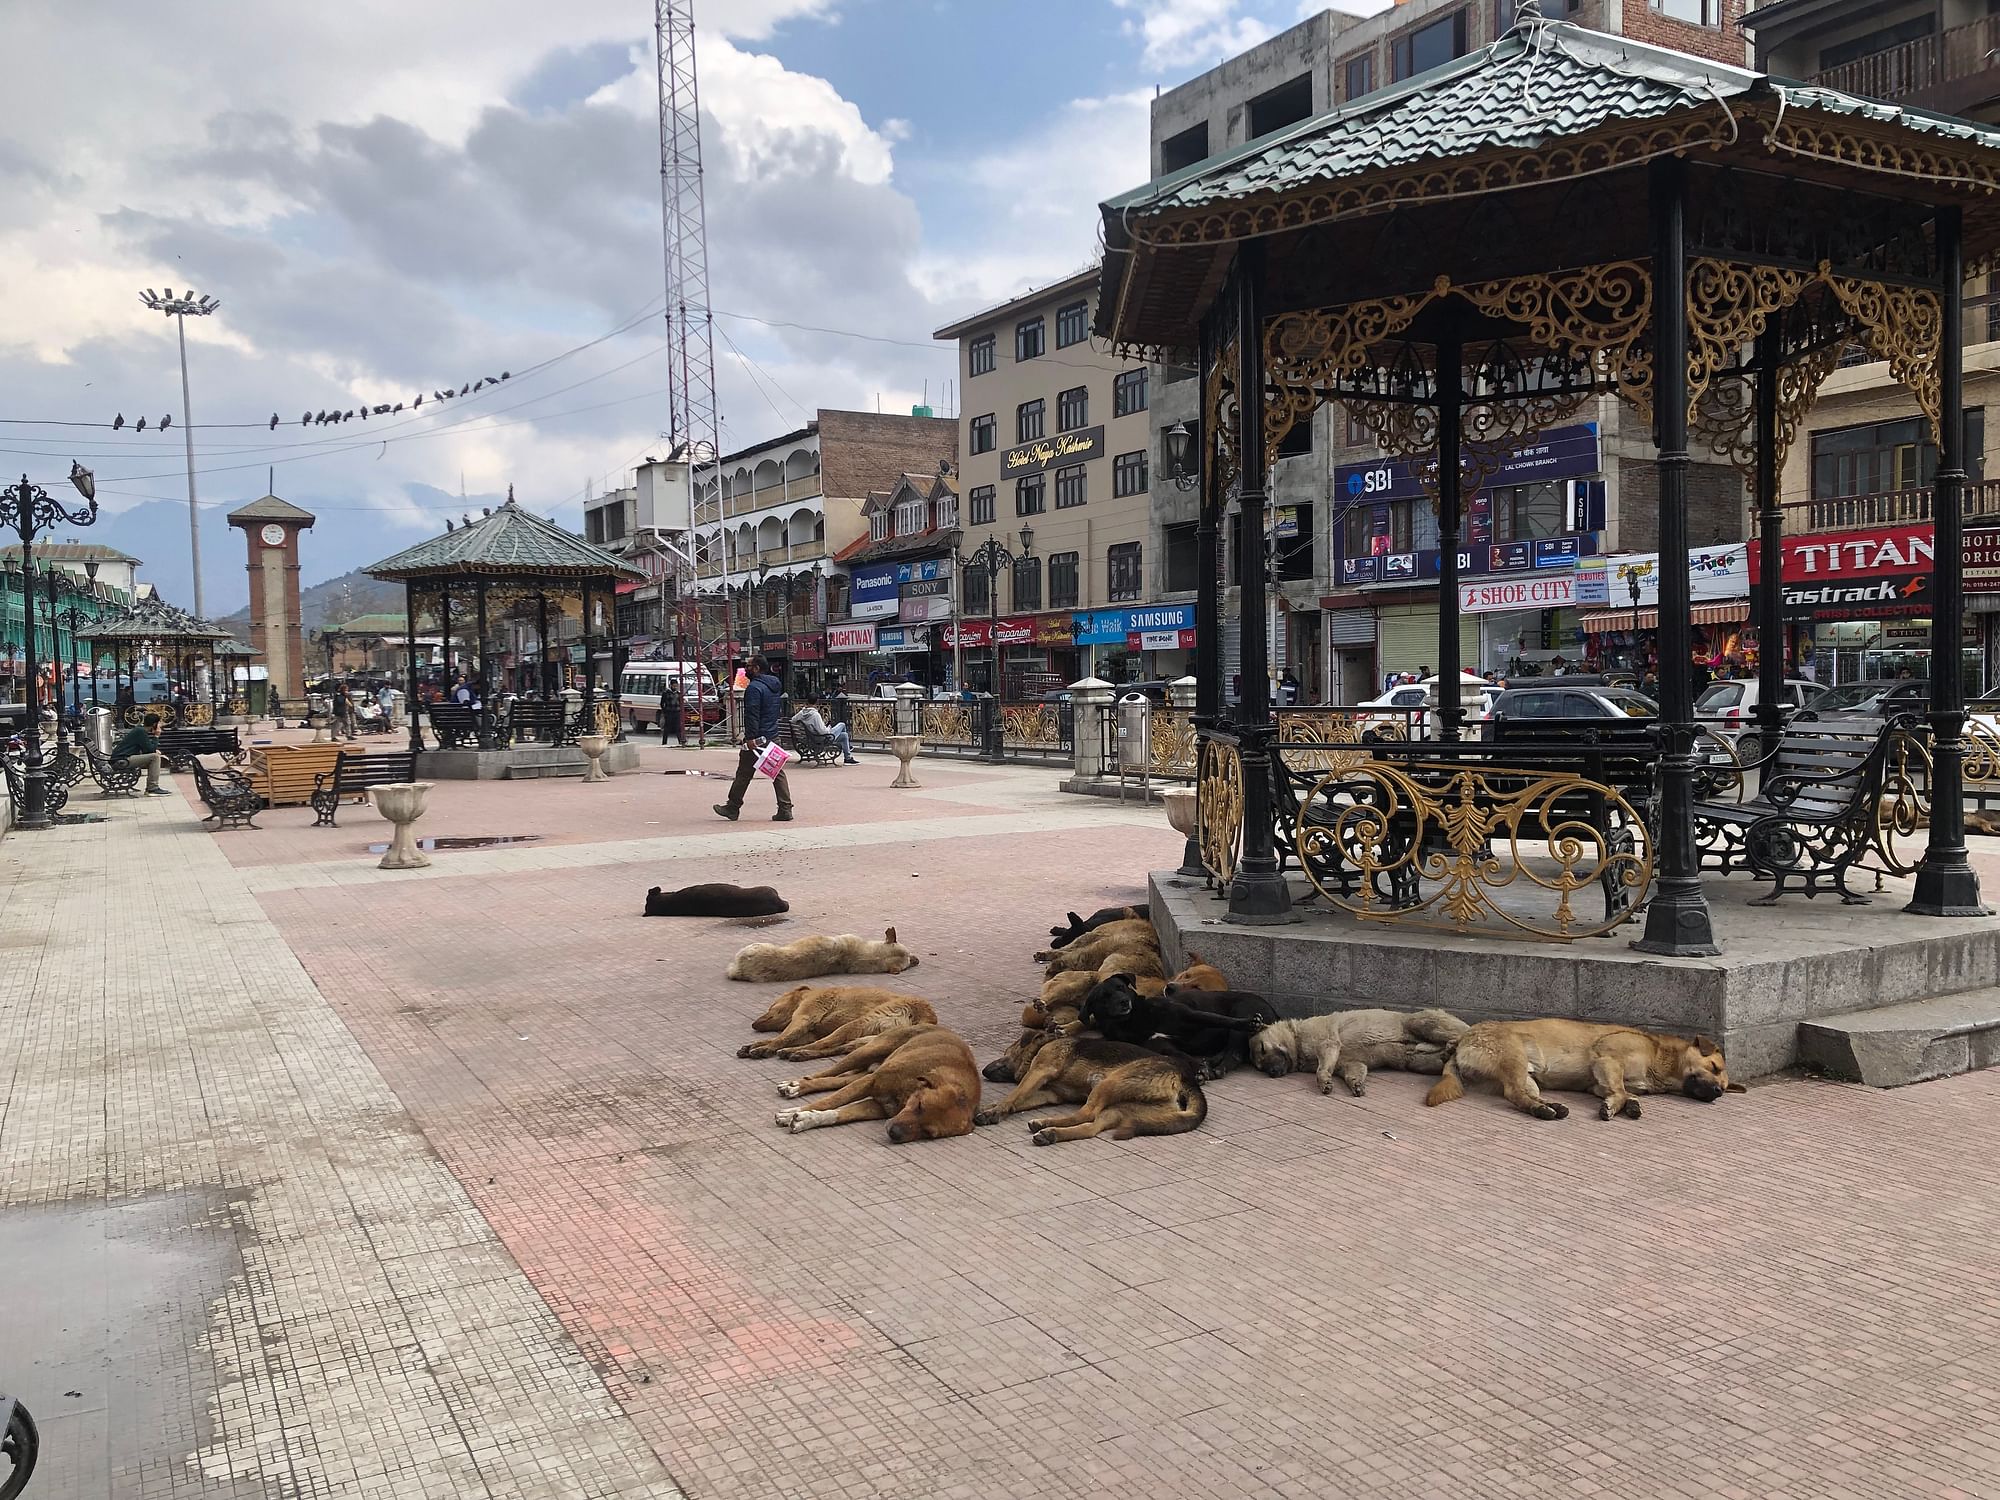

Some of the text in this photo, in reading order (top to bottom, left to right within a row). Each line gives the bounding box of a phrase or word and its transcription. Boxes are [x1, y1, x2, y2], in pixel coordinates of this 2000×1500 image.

[1007, 451, 1030, 468] Hotel
[1055, 436, 1094, 457] Kashmir
[1535, 457, 1557, 467] BRANCH
[1365, 468, 1392, 493] SBI
[1457, 552, 1471, 569] BI
[1794, 535, 1934, 573] TITAN
[1712, 568, 1730, 577] TOYS
[856, 573, 893, 590] Panasonic
[912, 582, 938, 595] SONY
[1481, 580, 1572, 605] SHOE CITY
[914, 605, 923, 616] LG
[1854, 603, 1932, 617] COLLECTION
[1130, 611, 1183, 628] SAMSUNG
[831, 629, 873, 647] RIGHTWAY
[881, 632, 902, 641] SAMSUNG
